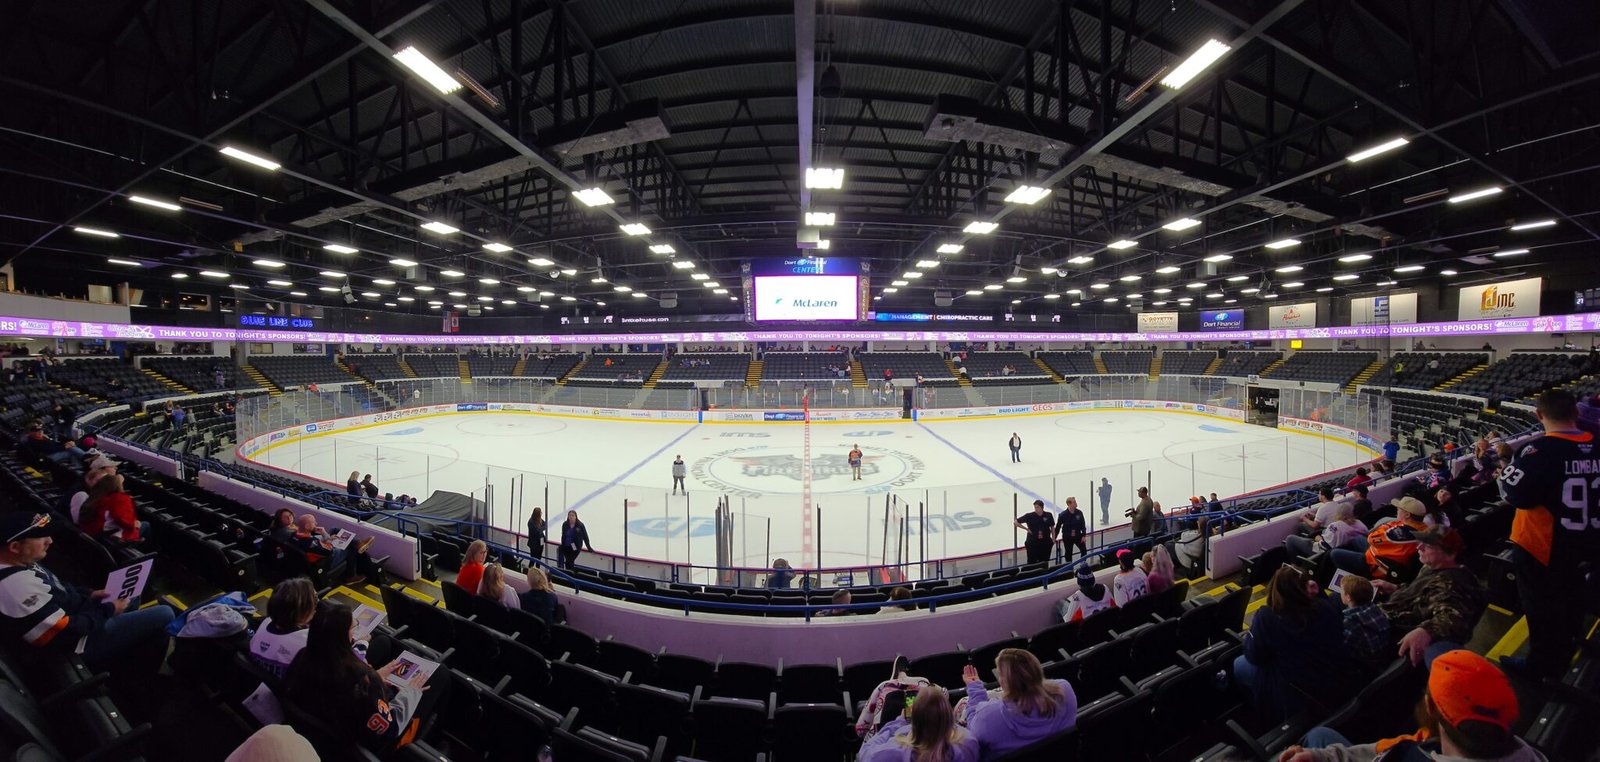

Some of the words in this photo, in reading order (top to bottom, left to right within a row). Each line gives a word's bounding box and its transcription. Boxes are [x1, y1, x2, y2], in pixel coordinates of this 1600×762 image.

[792, 299, 838, 307] McLaren
[240, 315, 265, 326] BLUE
[269, 316, 288, 327] LINE
[292, 317, 314, 328] CLUB
[1442, 323, 1492, 332] SPONSORS!
[1565, 460, 1600, 474] LOMBA
[1501, 465, 1524, 486] 93
